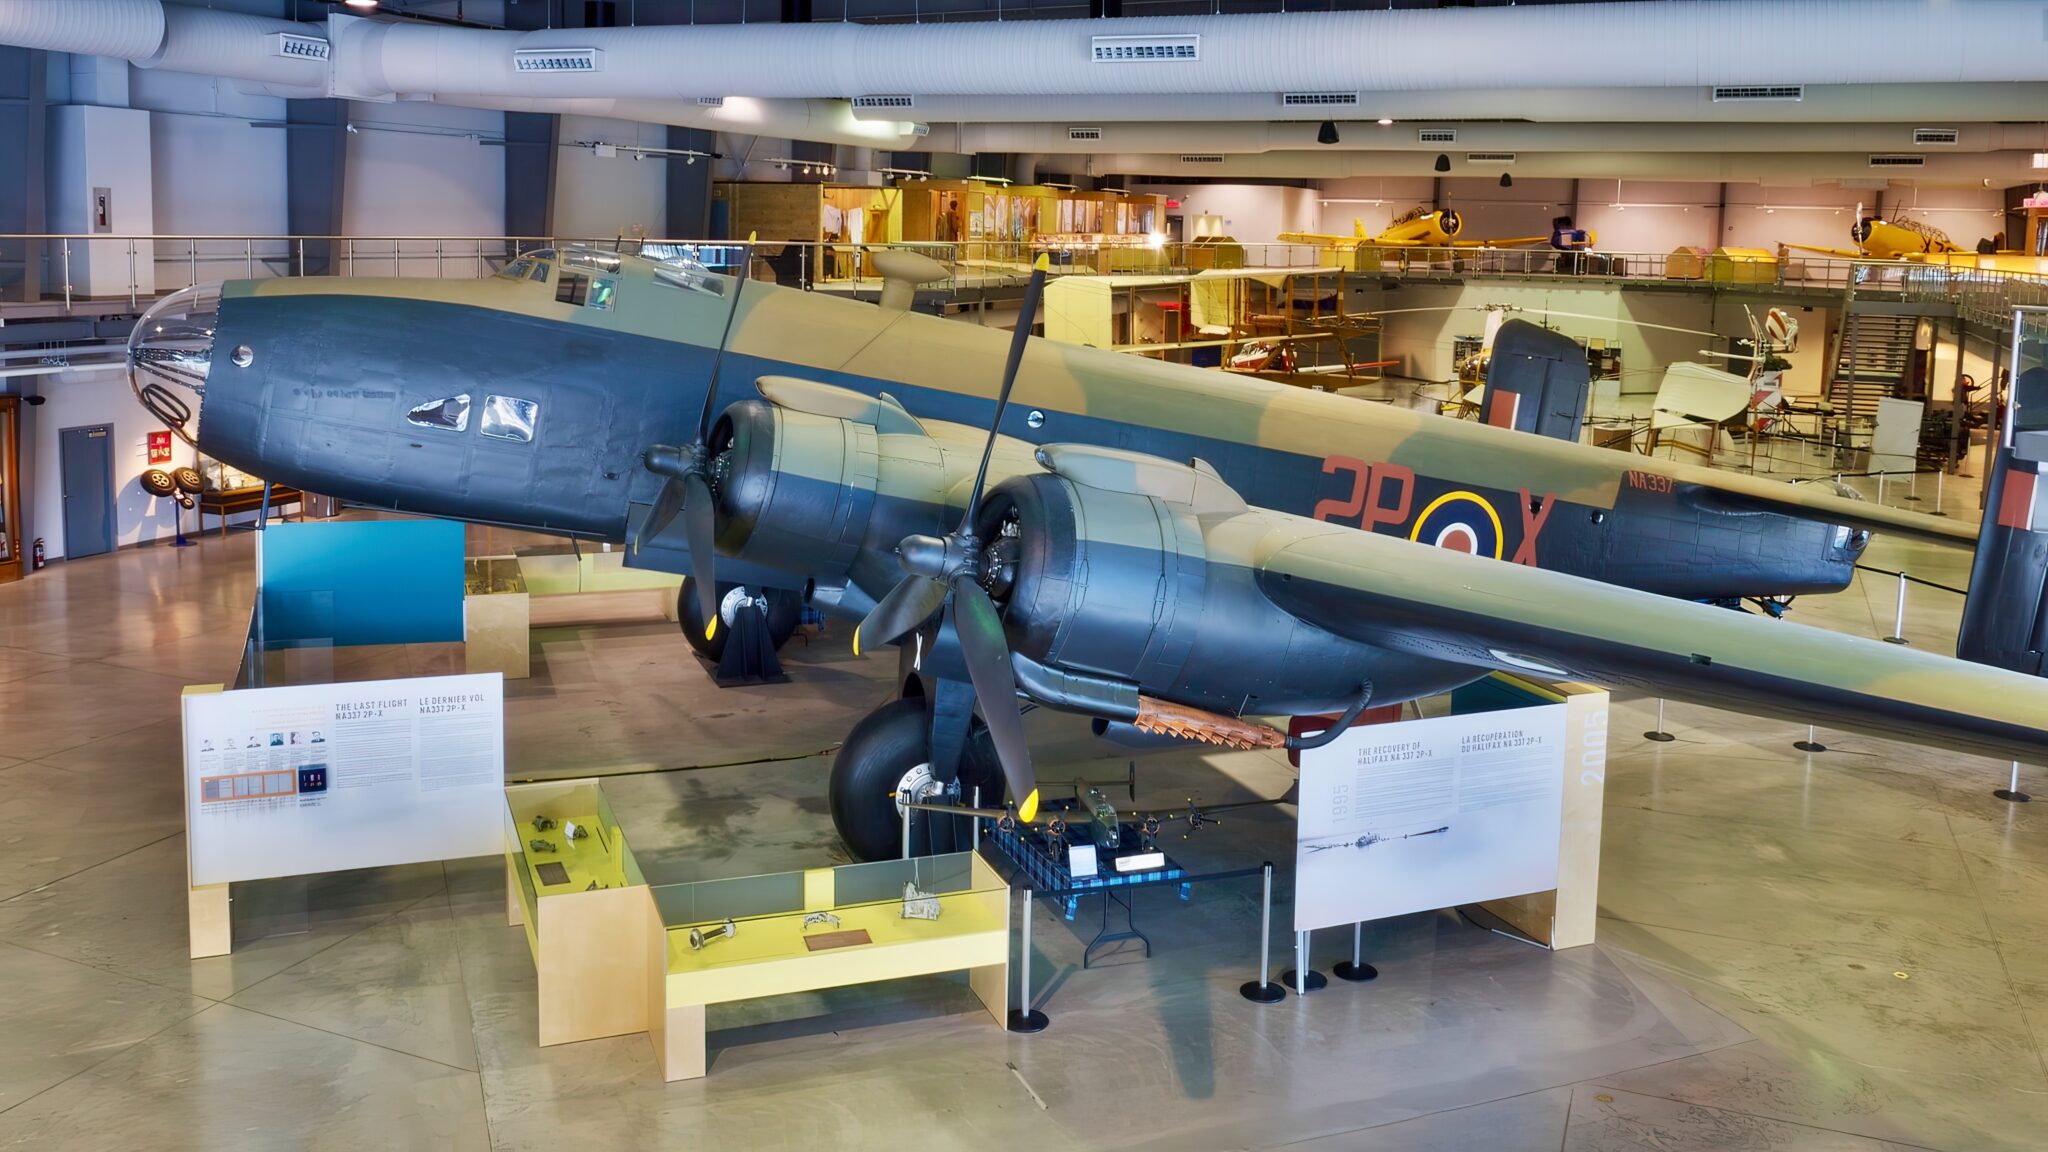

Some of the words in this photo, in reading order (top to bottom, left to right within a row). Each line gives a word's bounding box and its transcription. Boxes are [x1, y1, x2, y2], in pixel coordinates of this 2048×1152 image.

[1628, 470, 1673, 493] NA337
[1313, 455, 1415, 532] 2P
[1511, 487, 1556, 567] X
[336, 703, 350, 711] THE
[353, 701, 375, 710] LAST
[378, 699, 408, 709] FLIGHT
[419, 697, 428, 706] LE
[431, 694, 466, 705] DERNIER
[469, 693, 485, 702] VOL
[335, 711, 361, 720] NA337
[363, 710, 384, 719] 2P-X
[419, 705, 444, 714] NA337
[446, 704, 466, 712] 2P-X
[1461, 736, 1471, 744] LA
[1461, 745, 1470, 753] DU
[1472, 741, 1501, 752] HALIFAX
[1503, 739, 1512, 748] NA
[1514, 738, 1525, 747] 337
[1526, 736, 1542, 746] 2P-X
[1358, 748, 1371, 756] THE
[1373, 743, 1410, 755] RECOVERY
[1412, 741, 1421, 749] OF
[1581, 711, 1608, 785] 2005
[1357, 754, 1388, 765] HALIFAX
[1391, 753, 1400, 761] NA
[1402, 752, 1414, 760] 337
[1416, 750, 1433, 758] 2P-X
[1332, 784, 1348, 823] 1995
